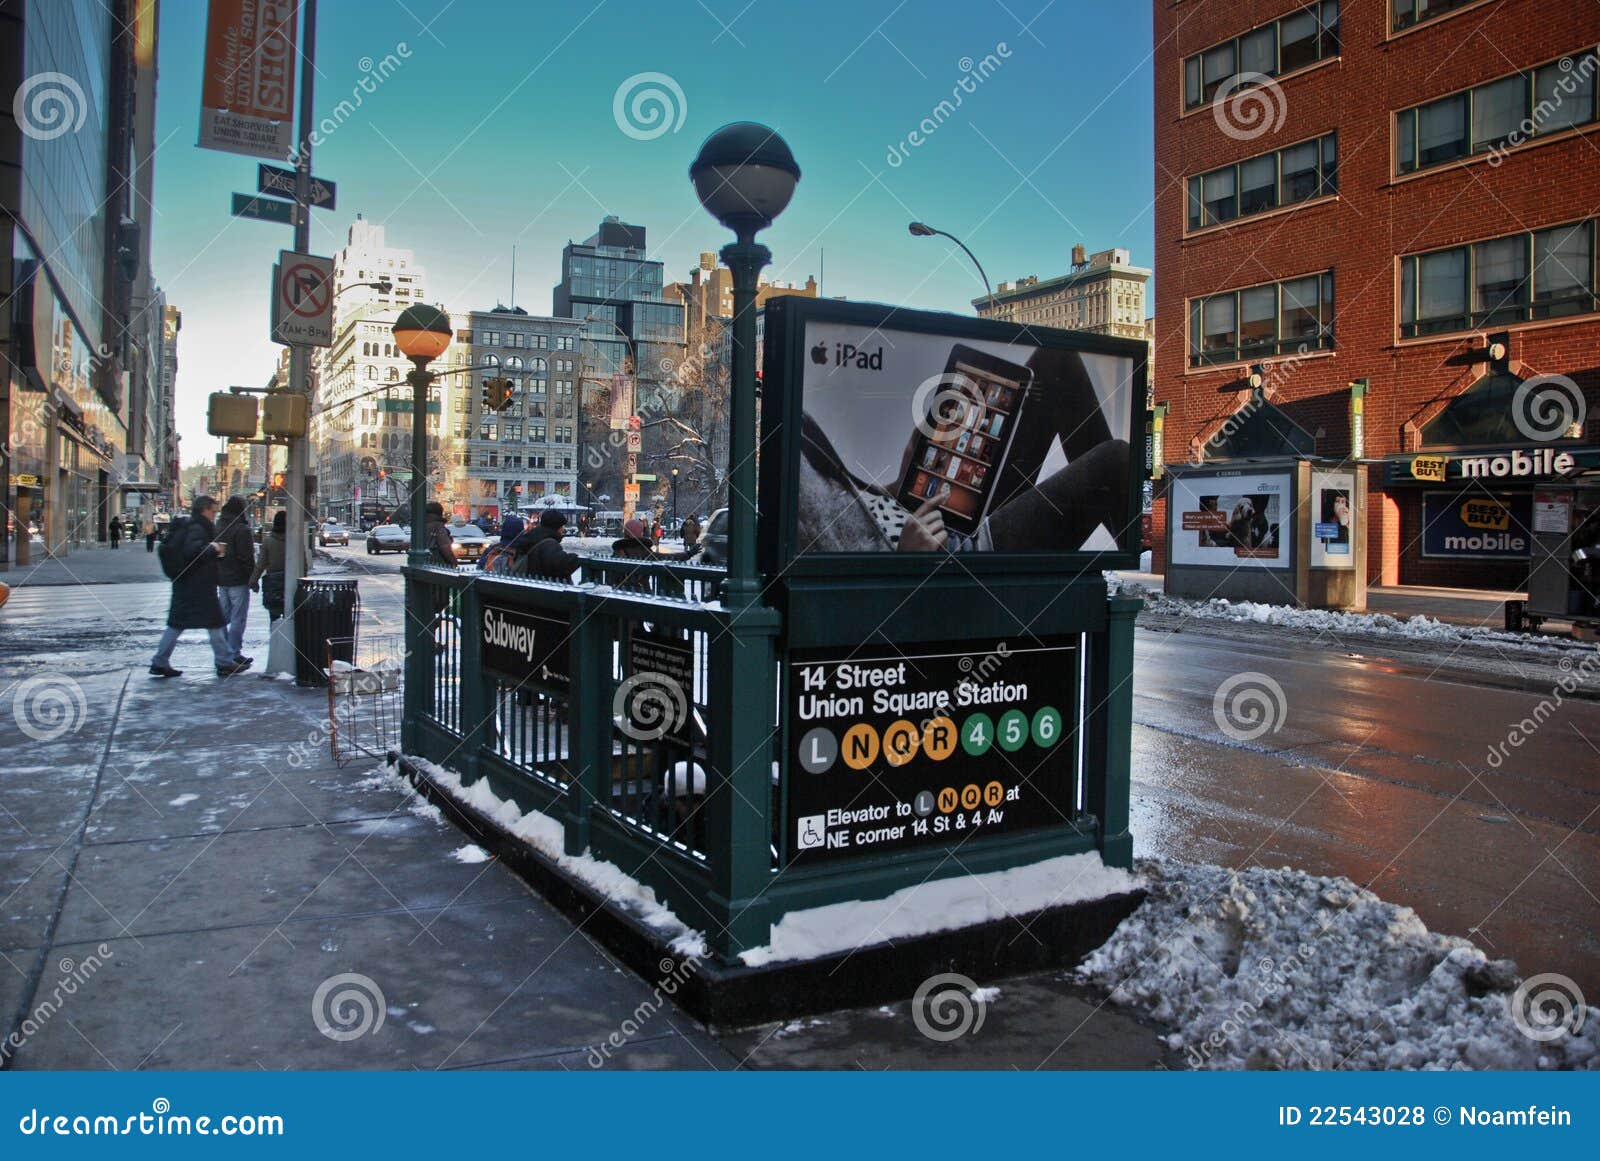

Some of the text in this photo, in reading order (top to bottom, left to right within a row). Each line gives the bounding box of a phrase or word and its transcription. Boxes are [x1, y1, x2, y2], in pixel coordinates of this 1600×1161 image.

[213, 24, 239, 106] celebrate
[236, 45, 254, 107] UNION
[213, 125, 241, 139] UNION
[270, 174, 325, 198] ONE AY
[247, 201, 279, 217] 4 AV
[836, 342, 883, 371] iPad
[1355, 415, 1363, 458] mobile
[1415, 460, 1444, 469] BEST
[1416, 468, 1441, 477] BUY
[1461, 448, 1575, 477] mobile
[1467, 503, 1506, 516] BEST
[1467, 513, 1505, 526] BUY
[1444, 533, 1525, 550] mobile
[484, 608, 535, 662] Subway
[800, 662, 906, 692] 14 Street
[798, 680, 1028, 720] Union Square Station
[811, 715, 1054, 764] L N Q R 4 5 6
[827, 785, 1020, 827] Elevator to L N Q R at
[827, 808, 1005, 850] NE corner 14 St & 4 Av
